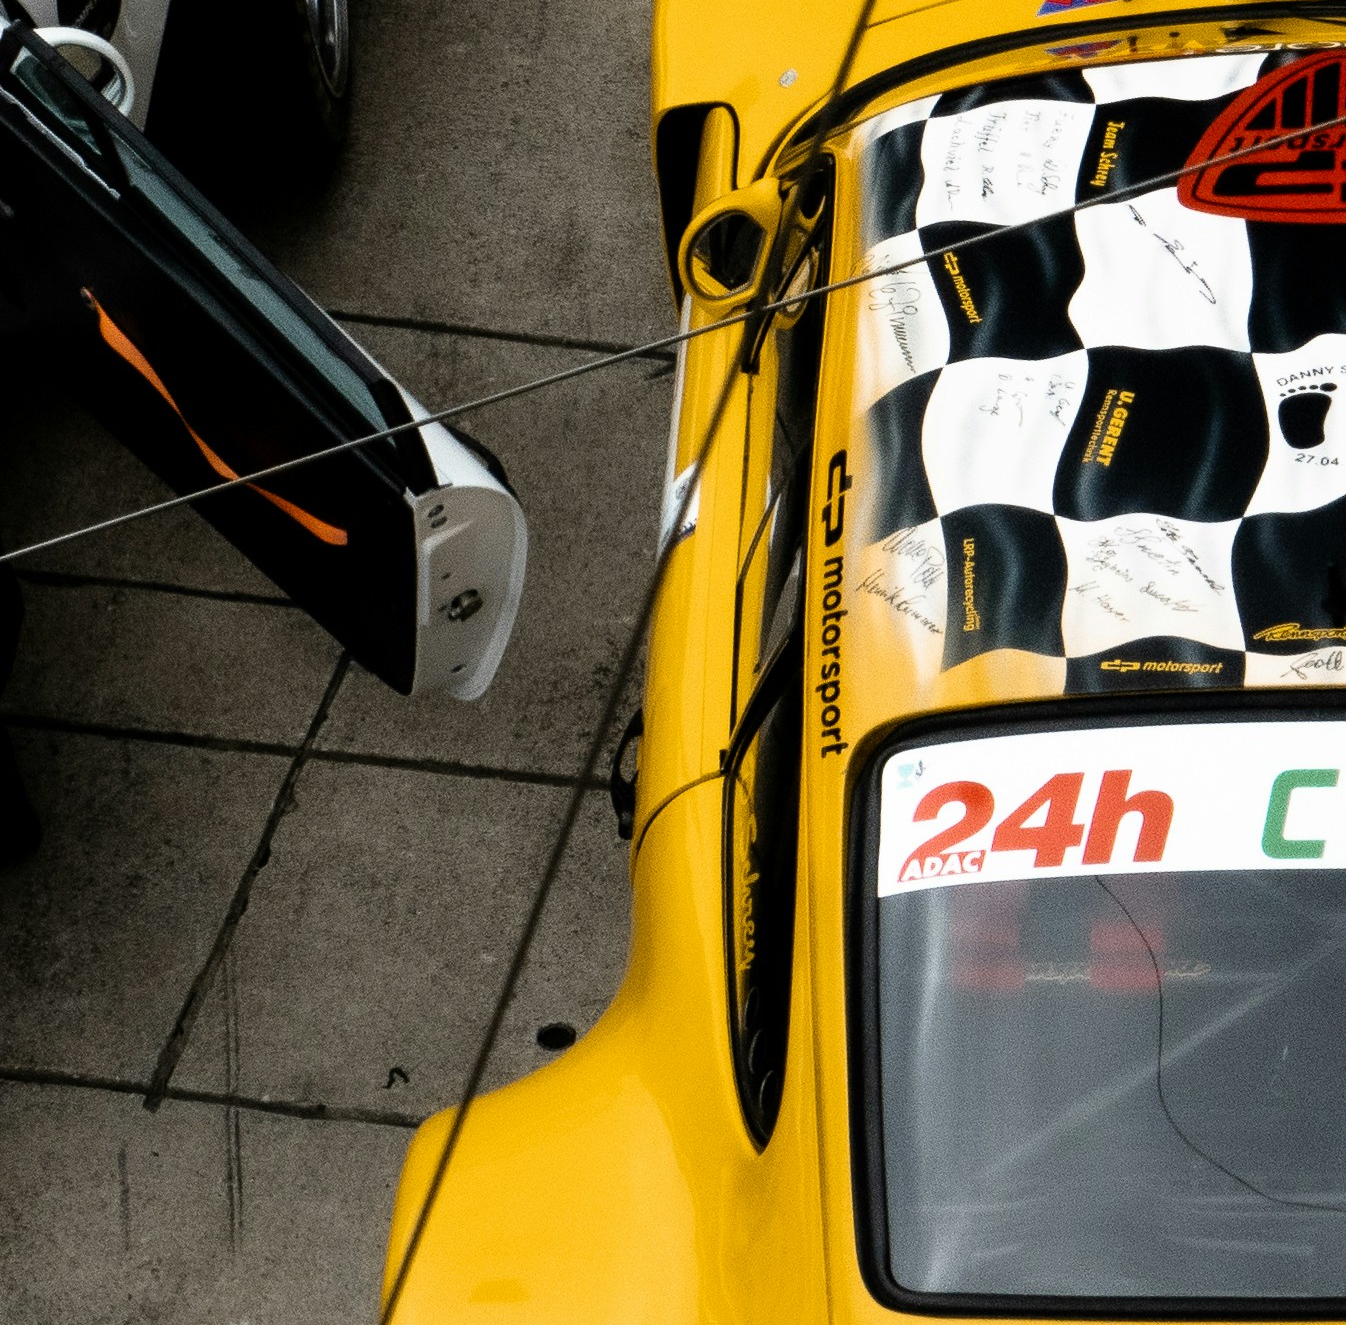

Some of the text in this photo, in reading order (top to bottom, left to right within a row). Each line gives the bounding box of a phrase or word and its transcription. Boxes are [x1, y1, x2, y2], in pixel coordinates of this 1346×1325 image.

[1089, 121, 1125, 188] Team Schrey
[952, 275, 984, 324] motorsport
[1276, 366, 1334, 387] DANNY
[820, 552, 850, 756] motorsport
[1142, 660, 1224, 675] motorsport
[898, 769, 1176, 882] 24h
[903, 851, 986, 882] ADAC
